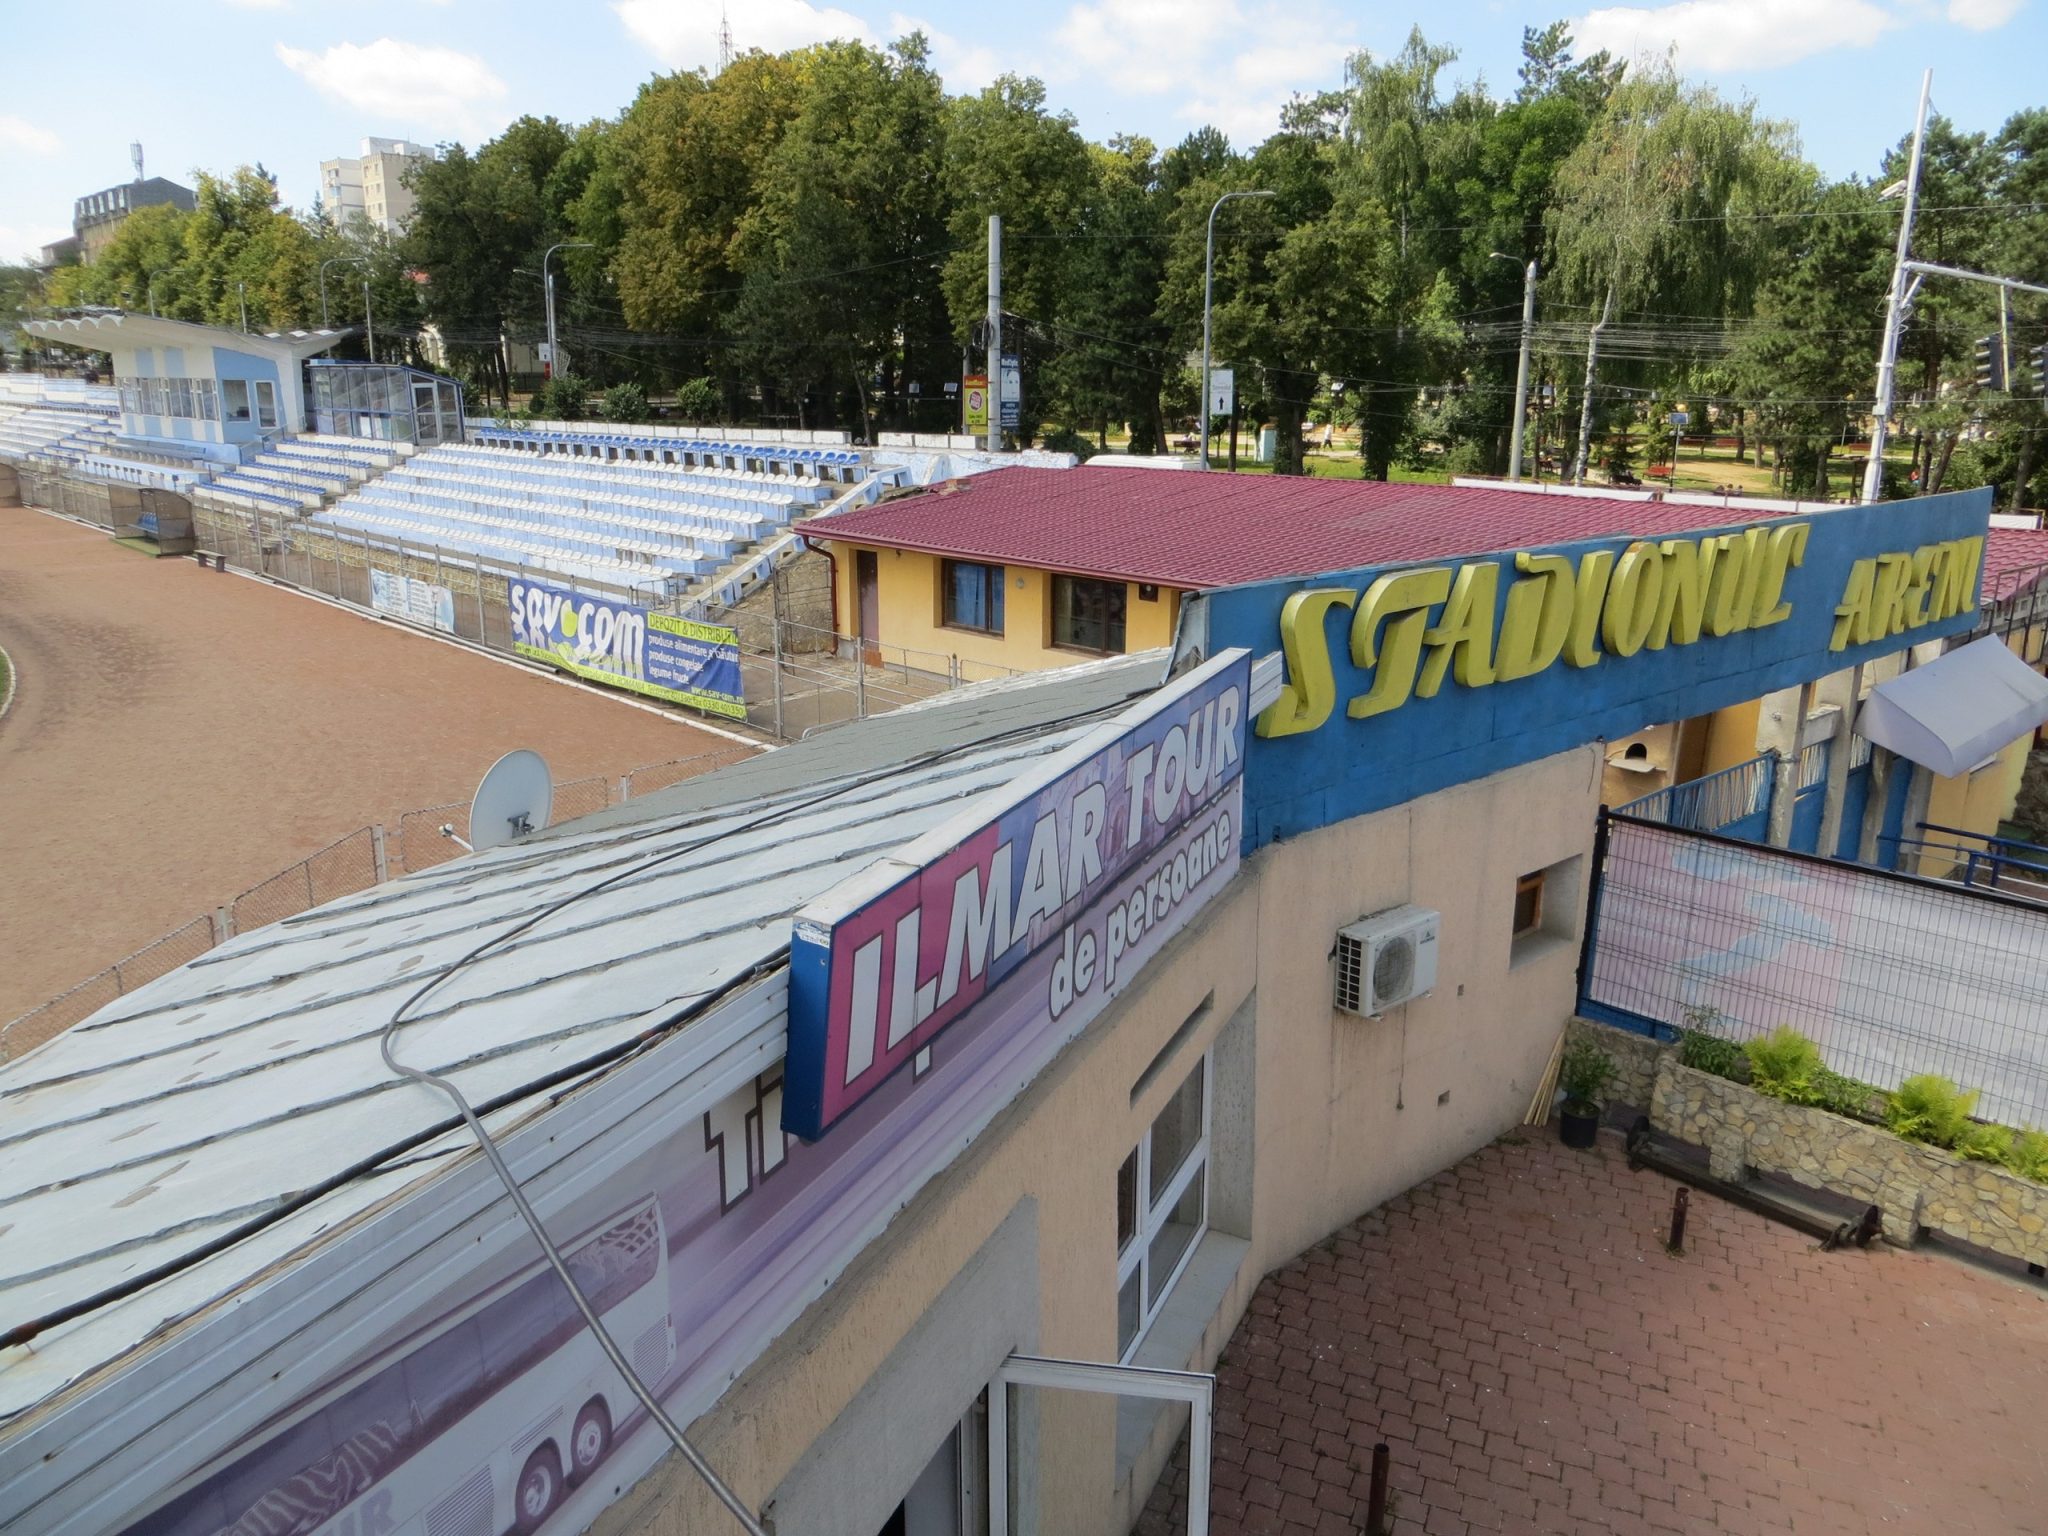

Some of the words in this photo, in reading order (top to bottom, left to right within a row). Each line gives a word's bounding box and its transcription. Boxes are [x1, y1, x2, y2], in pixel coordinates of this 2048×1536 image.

[648, 634, 674, 650] produse
[674, 640, 707, 658] alimentare
[648, 650, 674, 665] produse
[649, 613, 680, 634] DEPOZIT
[682, 622, 689, 635] &
[1255, 522, 1812, 739] STADIONUL
[844, 780, 1107, 1089] ILMAR
[1112, 685, 1241, 850] TOUR
[1048, 922, 1097, 1022] de
[1102, 810, 1232, 993] persoane
